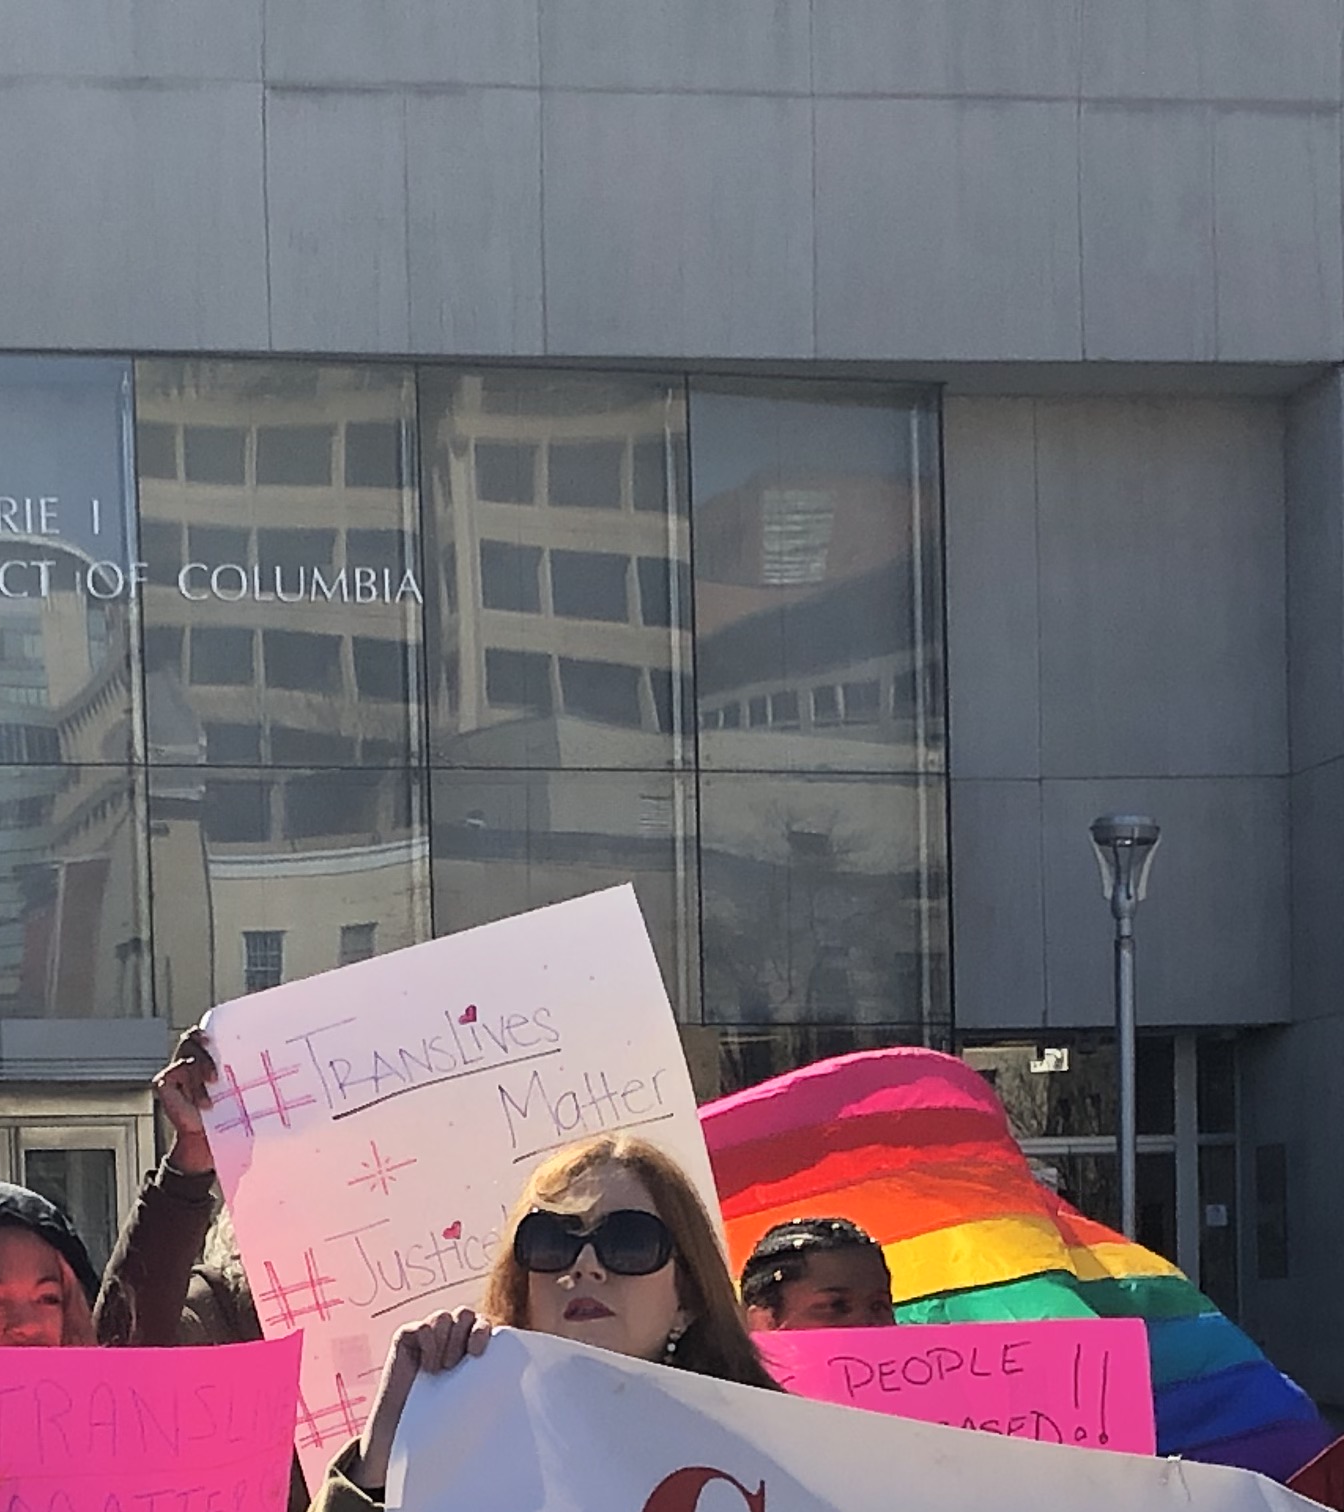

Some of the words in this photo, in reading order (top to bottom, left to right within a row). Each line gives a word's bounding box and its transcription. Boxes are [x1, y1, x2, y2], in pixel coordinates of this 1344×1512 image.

[86, 561, 151, 602] OF
[176, 561, 426, 605] COLUMBIA
[497, 1067, 667, 1149] Matter
[827, 1340, 1032, 1400] PEOPLE
